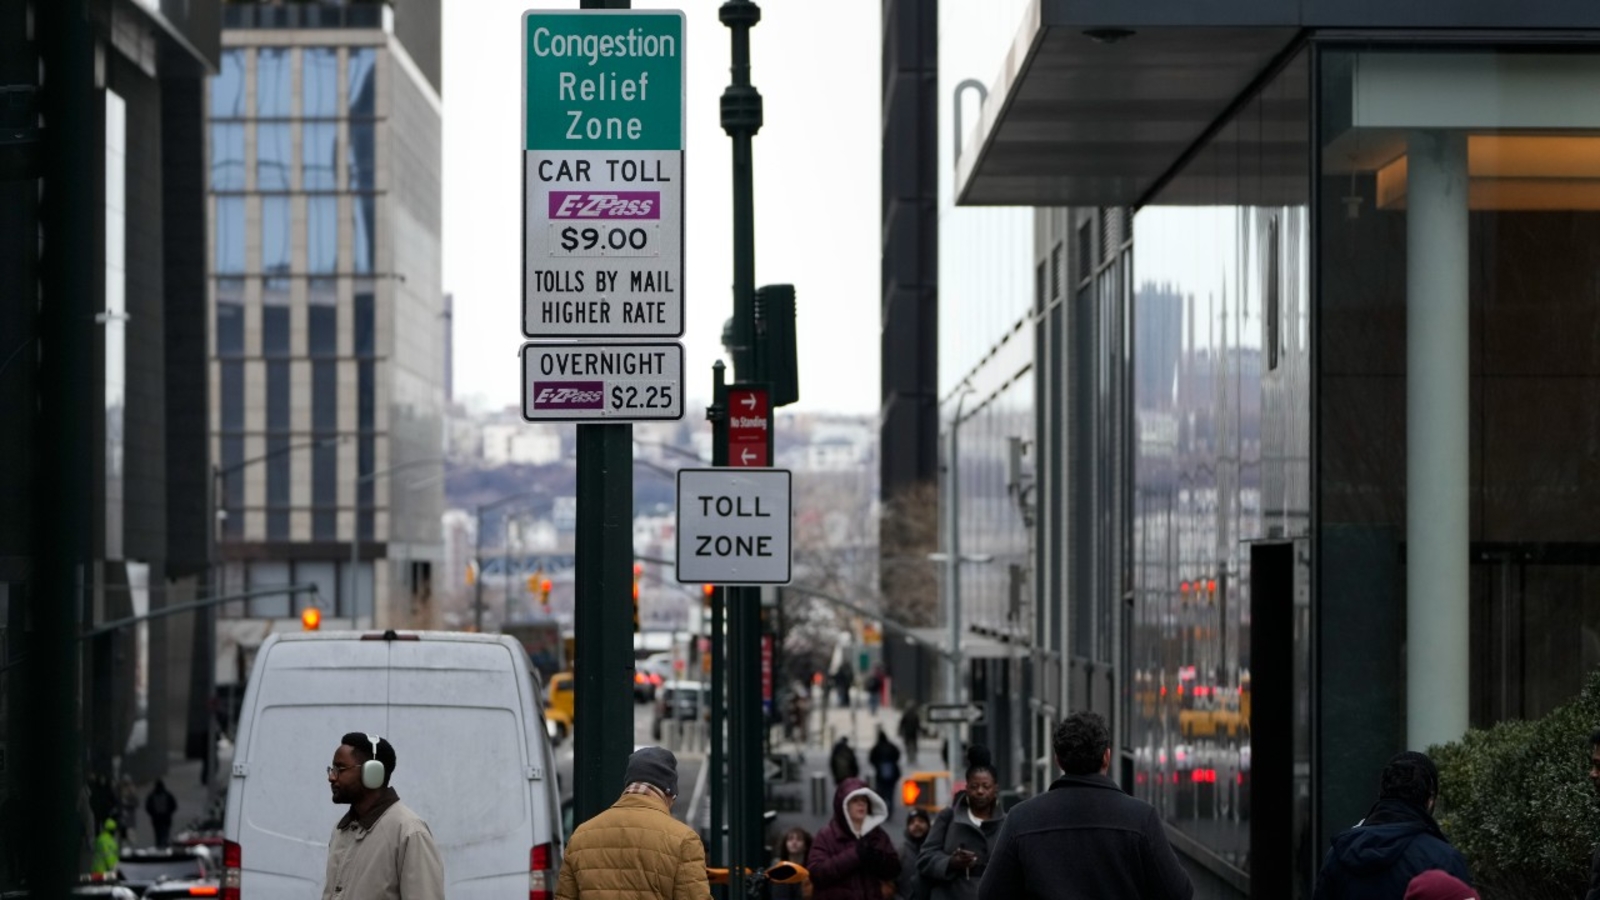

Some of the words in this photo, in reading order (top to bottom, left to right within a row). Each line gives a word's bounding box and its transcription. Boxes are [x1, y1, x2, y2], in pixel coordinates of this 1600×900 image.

[533, 27, 675, 66] Congestion
[559, 72, 648, 101] Relief
[566, 111, 642, 140] Zone
[538, 160, 591, 182] CAR
[606, 160, 670, 182] TOLL
[561, 226, 648, 253] $9.00
[535, 270, 584, 293] TOLLS
[596, 270, 618, 293] BY
[630, 270, 674, 293] MAIL
[542, 302, 610, 324] HIGHER
[623, 302, 666, 324] RATE
[541, 353, 666, 375] OVERNIGHT
[611, 385, 672, 410] $2.25
[730, 416, 739, 428] No
[740, 416, 767, 430] Standing
[698, 496, 770, 517] TOLL
[696, 536, 772, 556] ZONE
